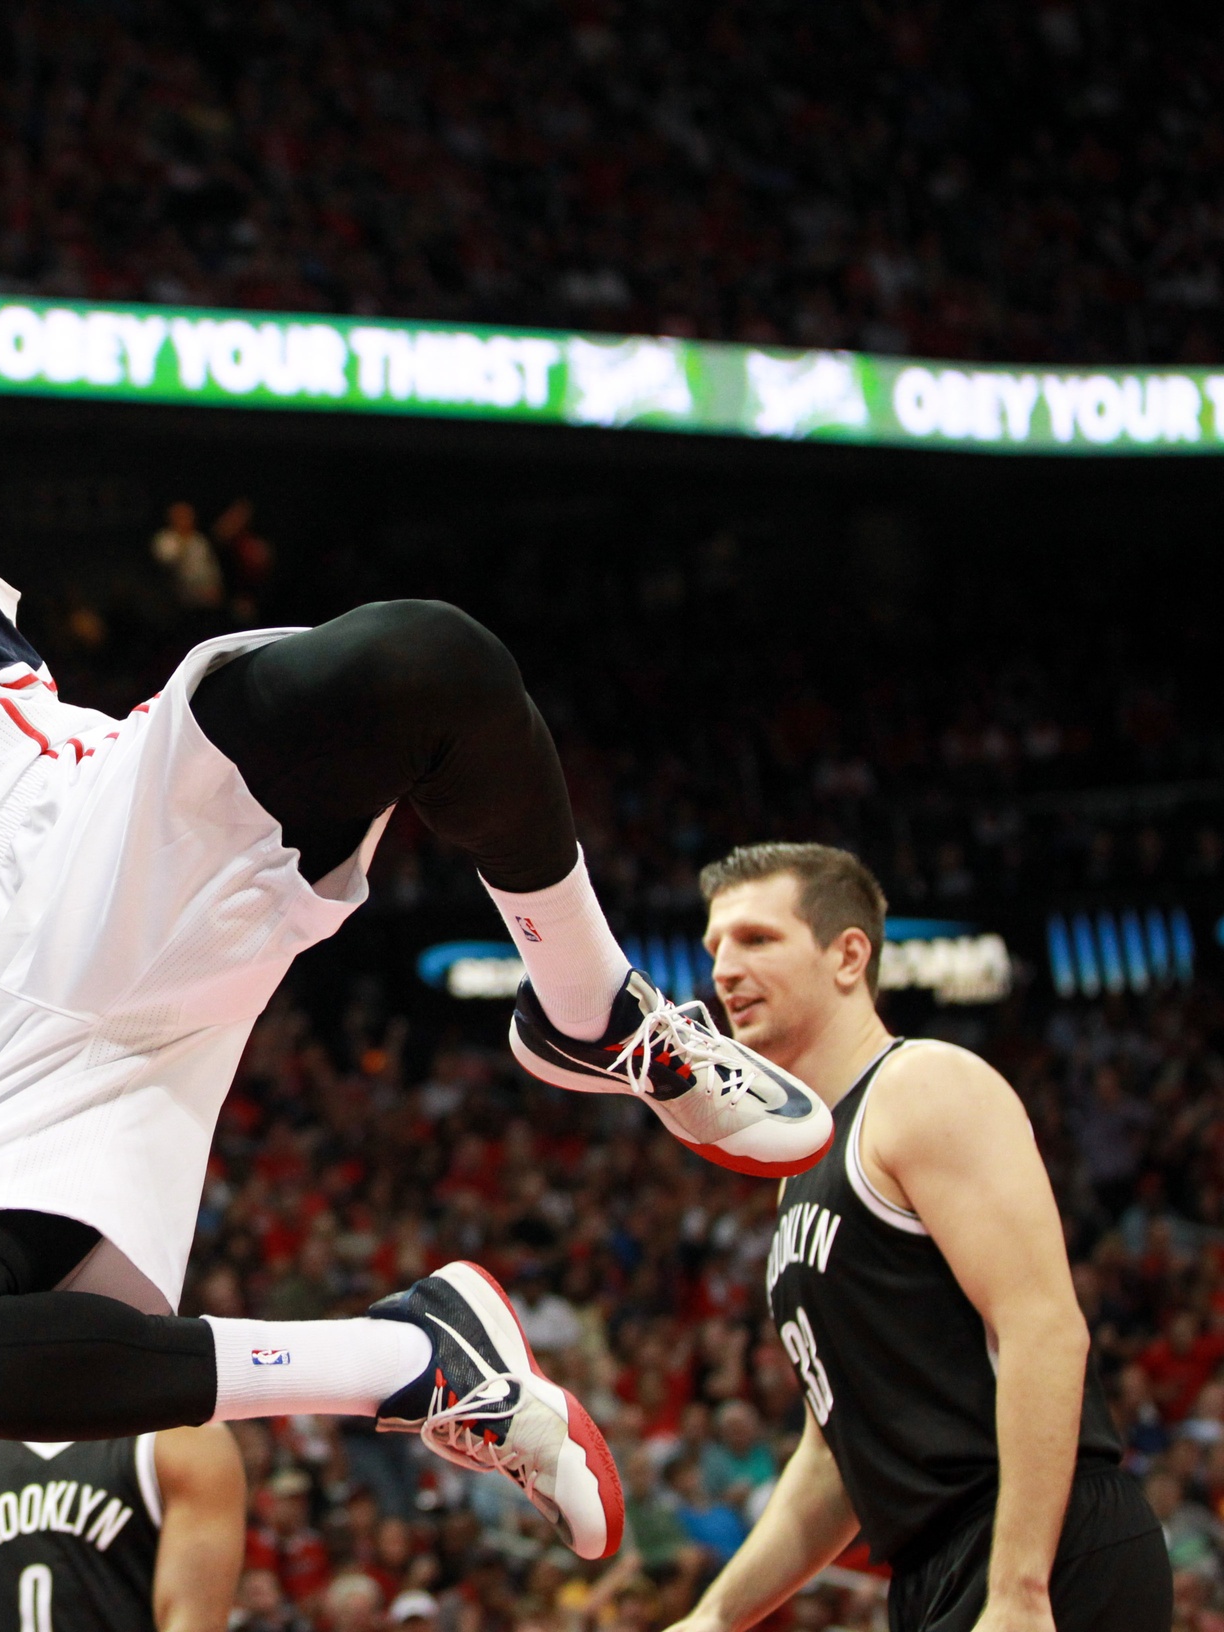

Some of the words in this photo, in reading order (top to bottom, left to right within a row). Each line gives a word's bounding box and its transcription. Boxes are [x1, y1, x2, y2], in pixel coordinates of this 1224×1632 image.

[170, 317, 347, 396] YOUR
[349, 327, 558, 408] THIRST
[893, 366, 1038, 440] OBEY
[1042, 374, 1203, 443] YOUR
[19, 1563, 53, 1632] 0
